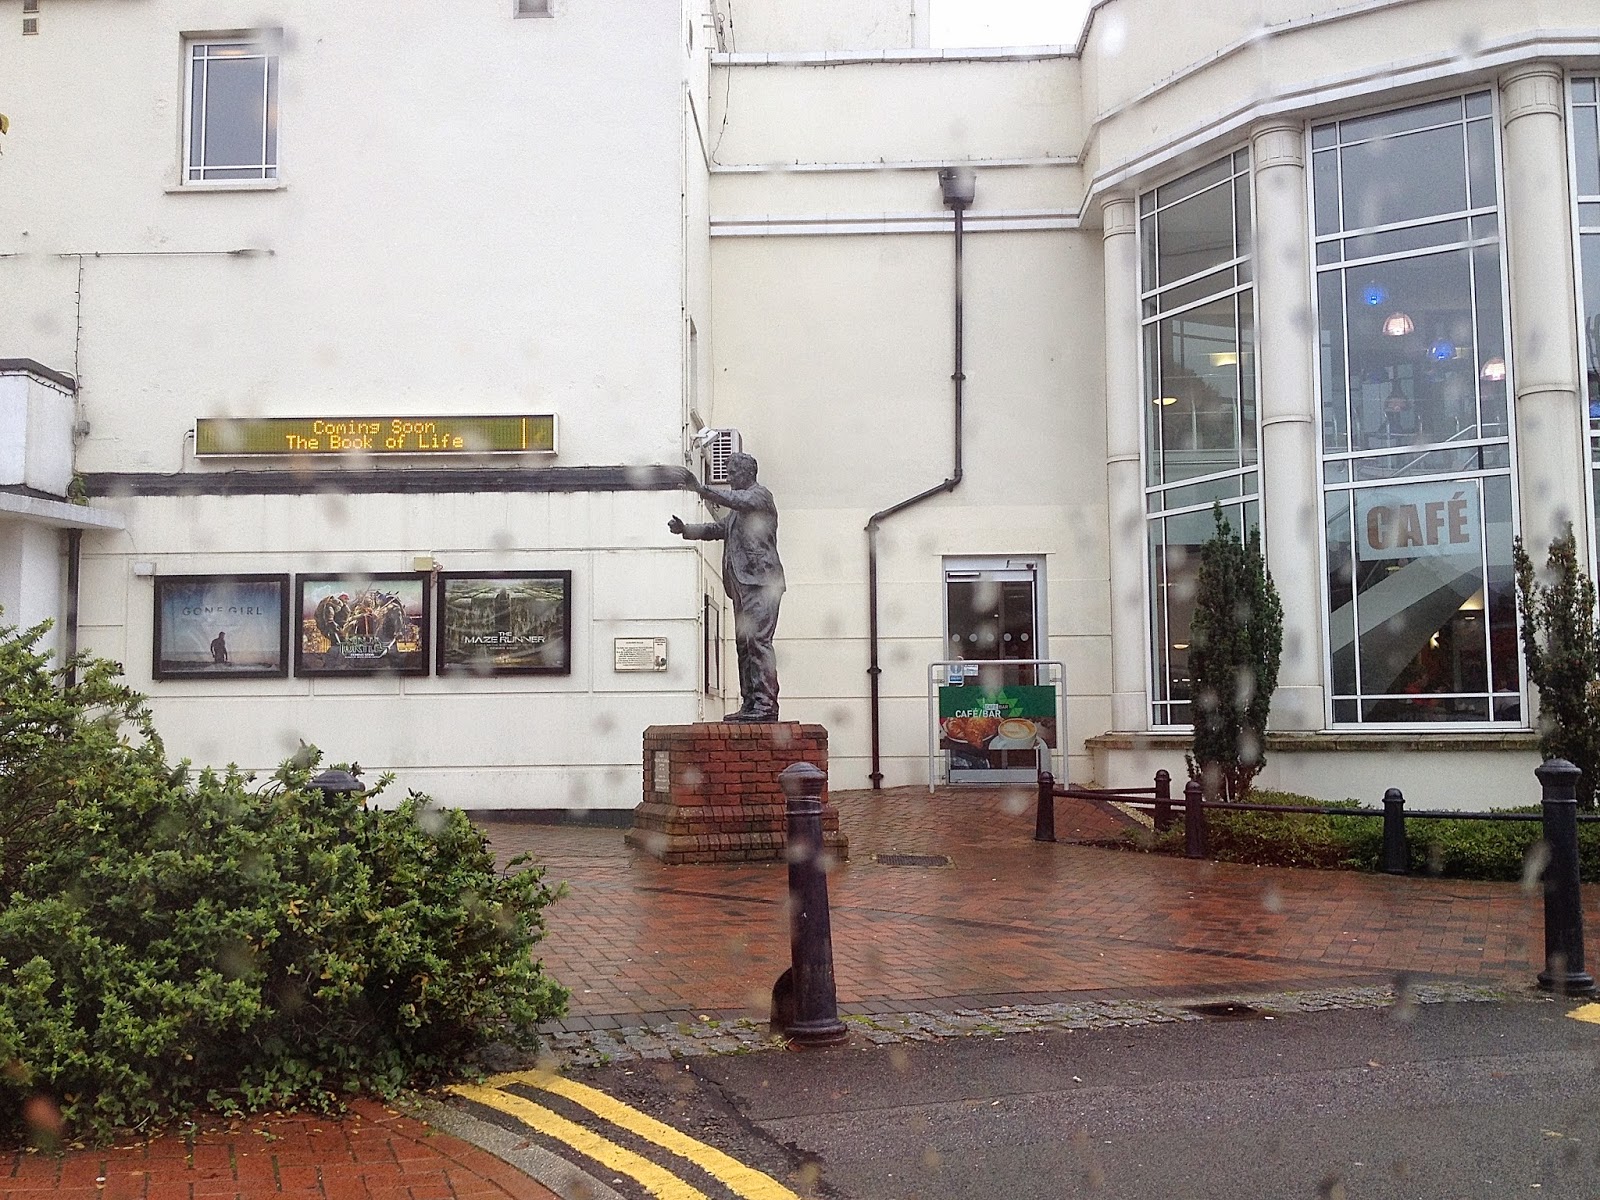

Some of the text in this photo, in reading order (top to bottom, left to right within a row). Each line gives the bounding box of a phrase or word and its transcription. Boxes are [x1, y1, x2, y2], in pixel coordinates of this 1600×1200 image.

[313, 419, 436, 435] Coming Soon
[286, 434, 464, 450] The Book of Life
[1366, 491, 1470, 550] CAFÉ
[464, 635, 546, 644] MAZE RUNNER
